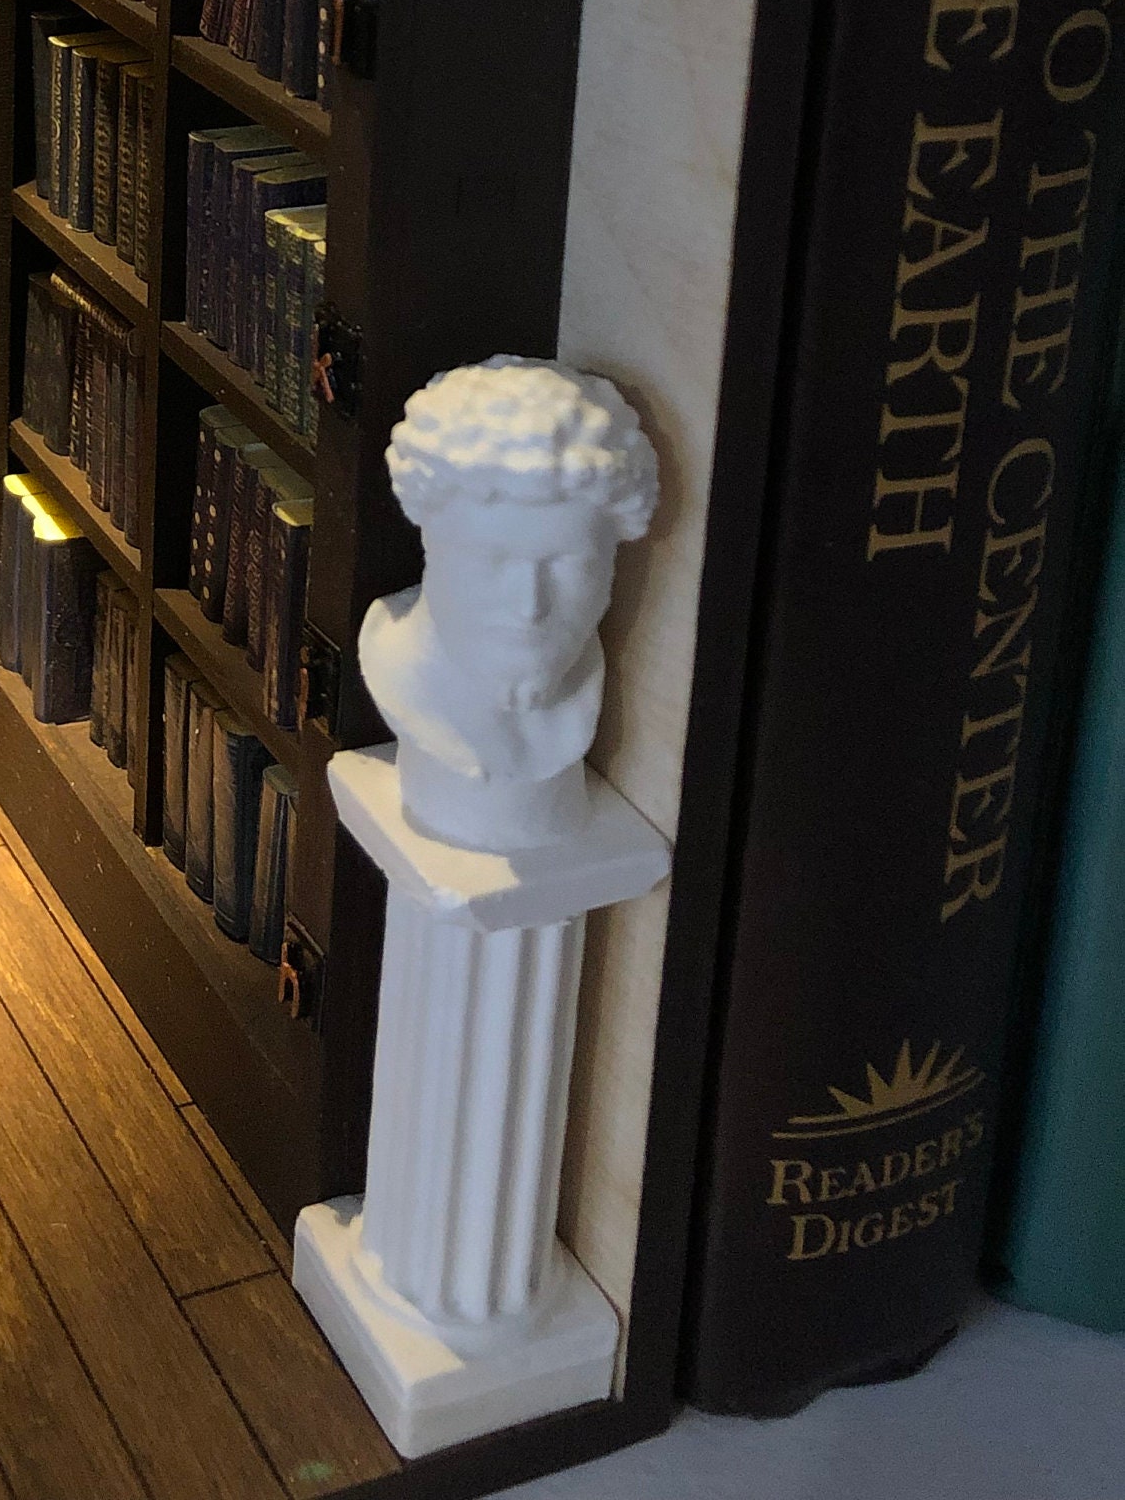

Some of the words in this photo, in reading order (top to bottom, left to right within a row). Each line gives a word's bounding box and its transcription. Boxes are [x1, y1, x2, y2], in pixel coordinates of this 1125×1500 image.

[866, 108, 1005, 562] EARTH
[1001, 128, 1098, 411] THE
[939, 437, 1056, 925] CENTER
[786, 1180, 963, 1261] DIGEST
